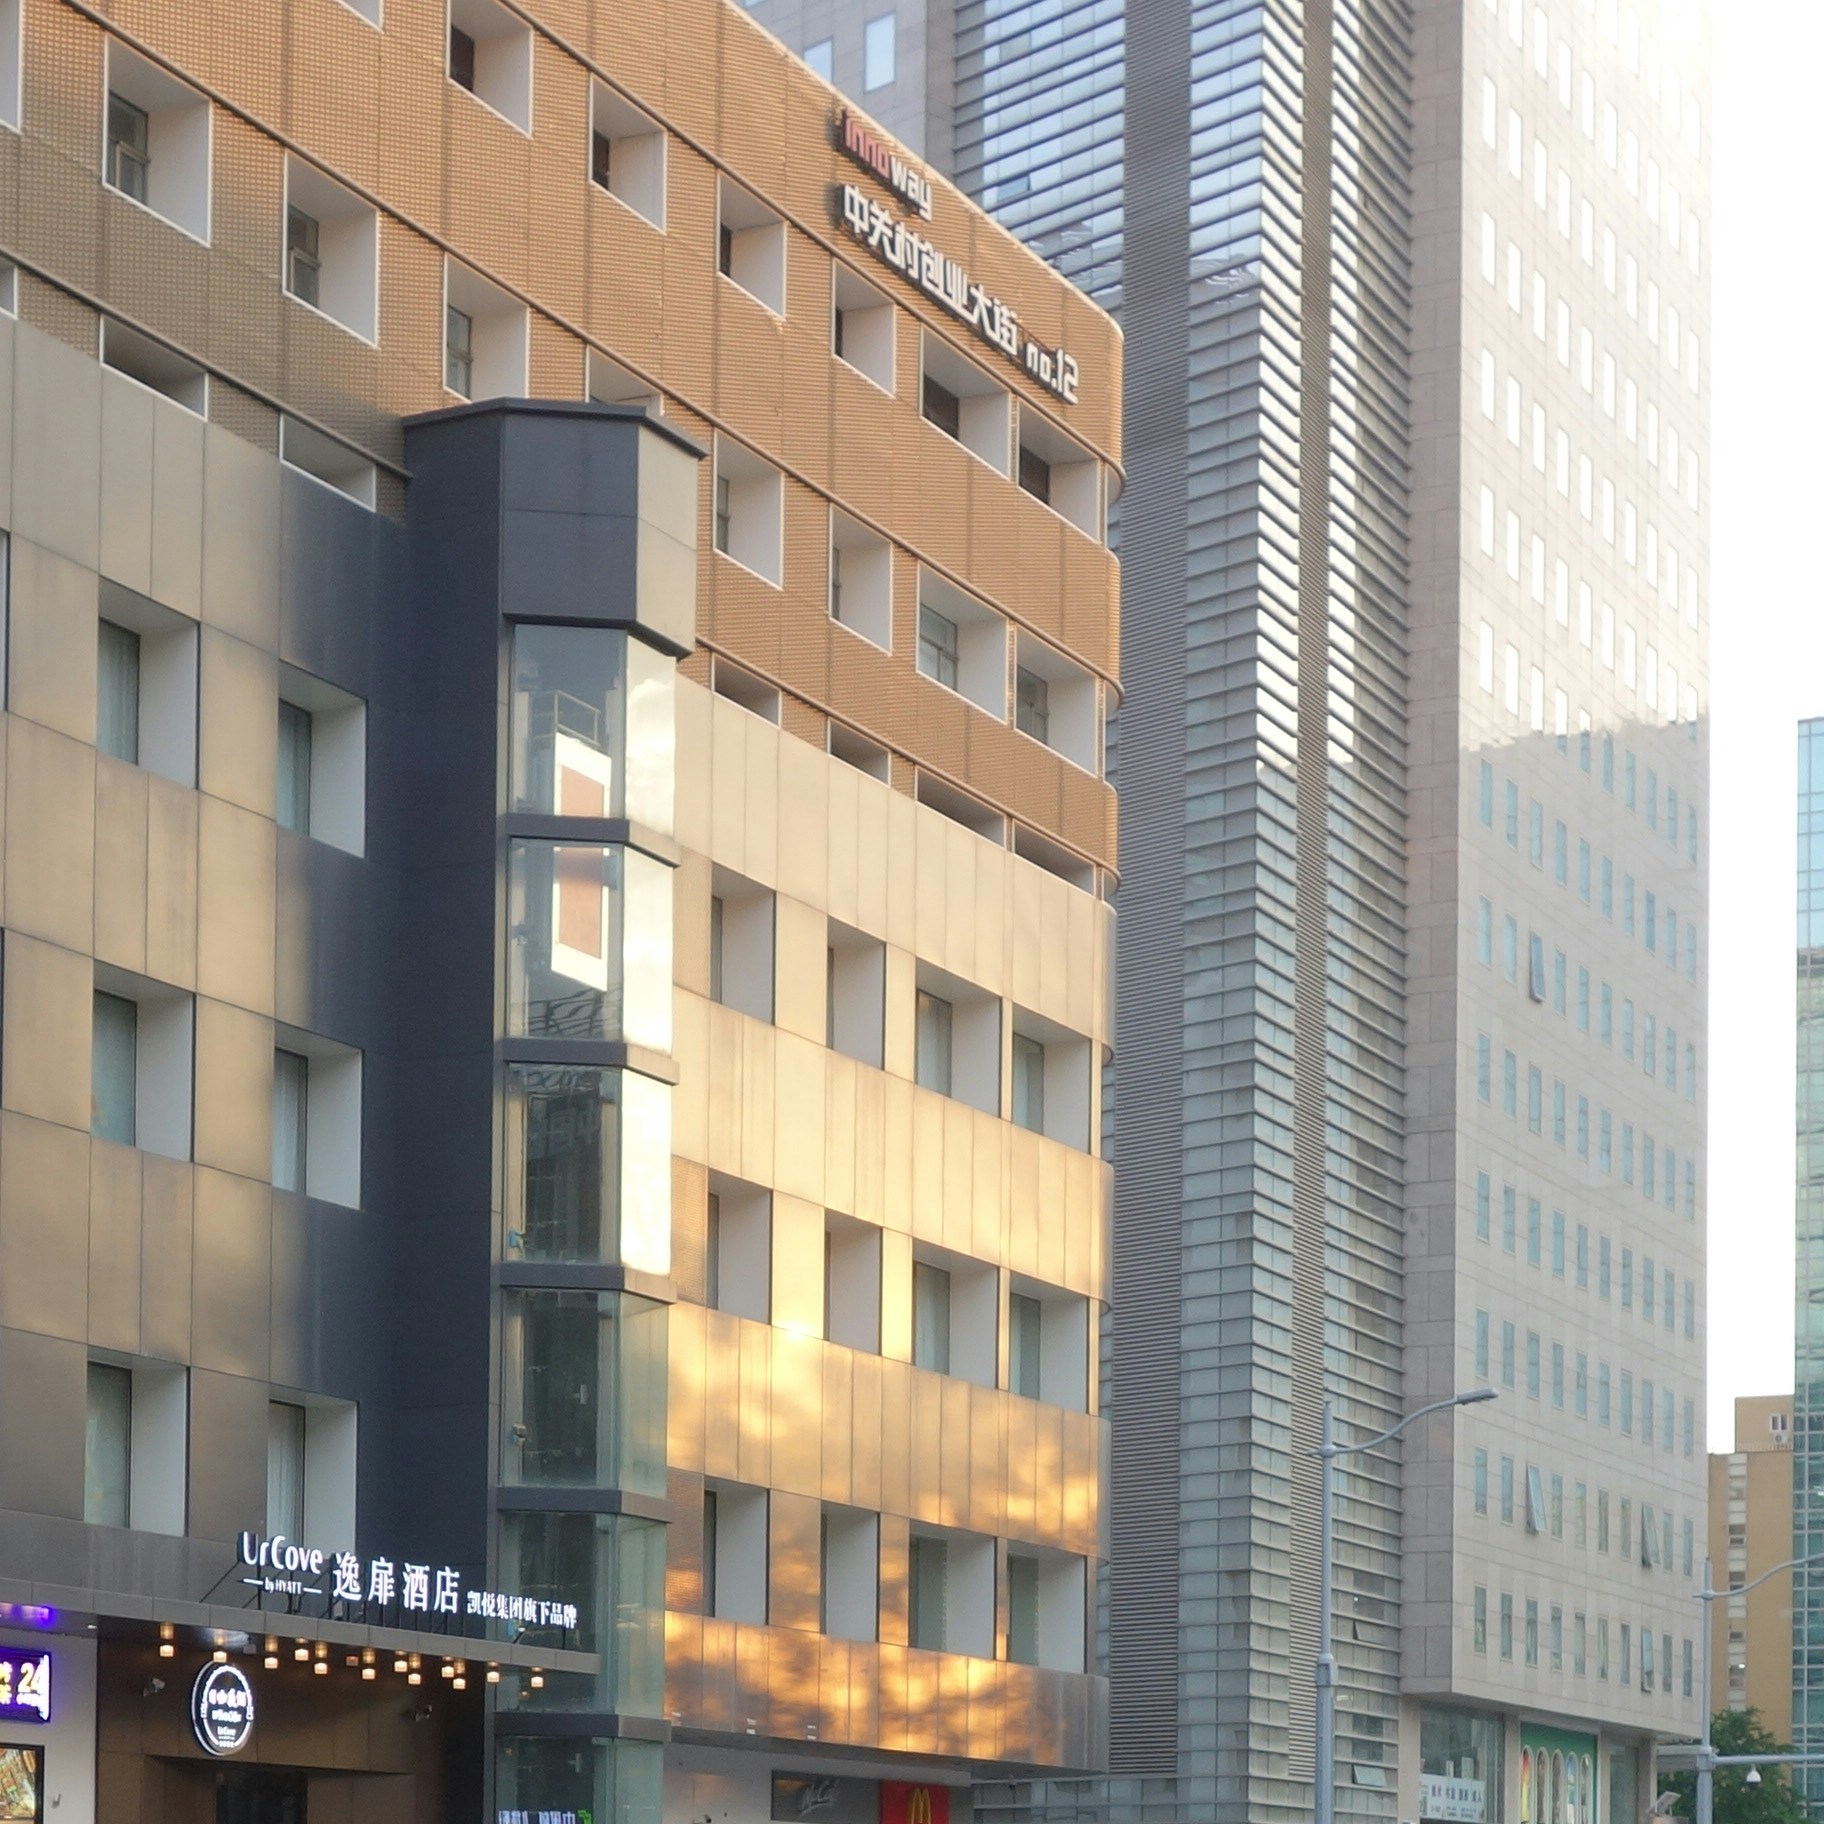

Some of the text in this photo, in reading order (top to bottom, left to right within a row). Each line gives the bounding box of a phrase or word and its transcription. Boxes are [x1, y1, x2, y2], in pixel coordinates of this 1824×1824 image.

[843, 112, 932, 221] innoway
[844, 185, 1078, 404] 中关村创业大街 no.12
[242, 1531, 578, 1629] UrCove 逸扉酒店 凯悦集团旗下品牌
[275, 1578, 303, 1595] HYATT
